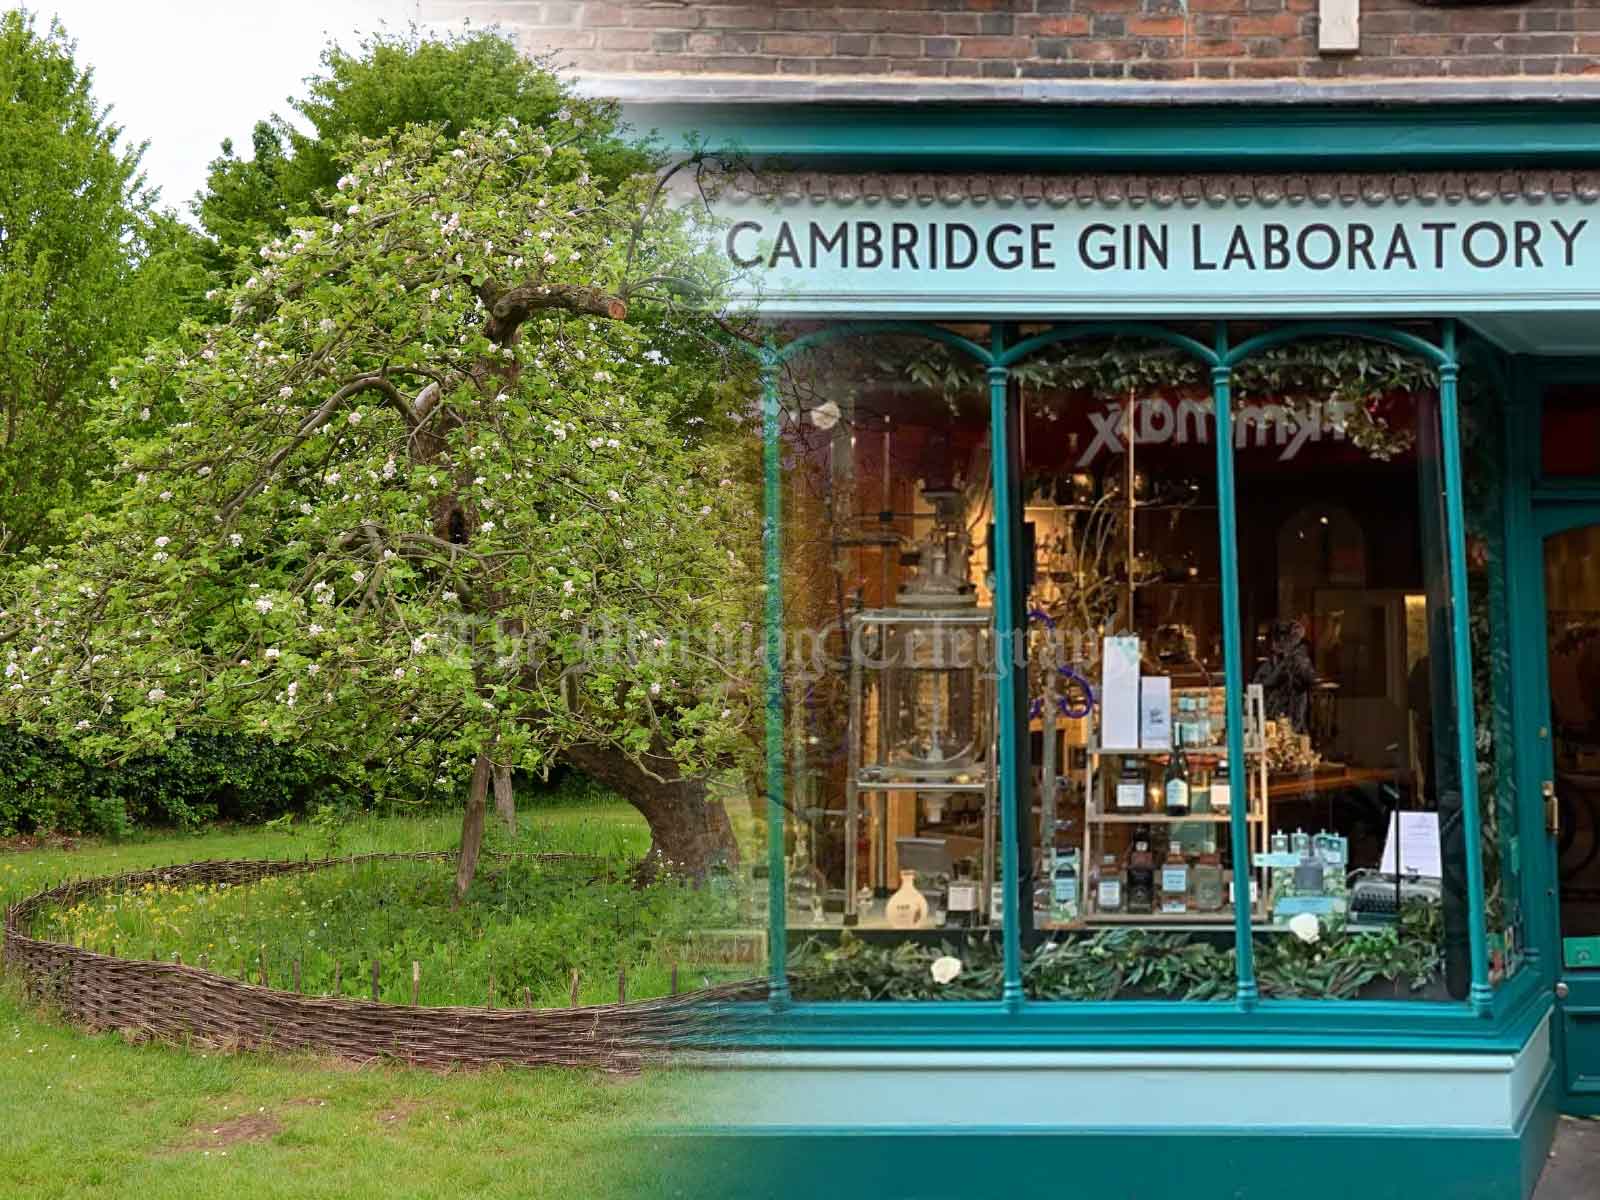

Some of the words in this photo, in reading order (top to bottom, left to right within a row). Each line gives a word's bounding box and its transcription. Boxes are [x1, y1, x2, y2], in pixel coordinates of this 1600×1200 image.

[726, 219, 1057, 271] CAMBRIDGE
[1077, 222, 1169, 271] GIN
[1191, 218, 1589, 271] LABORATORY
